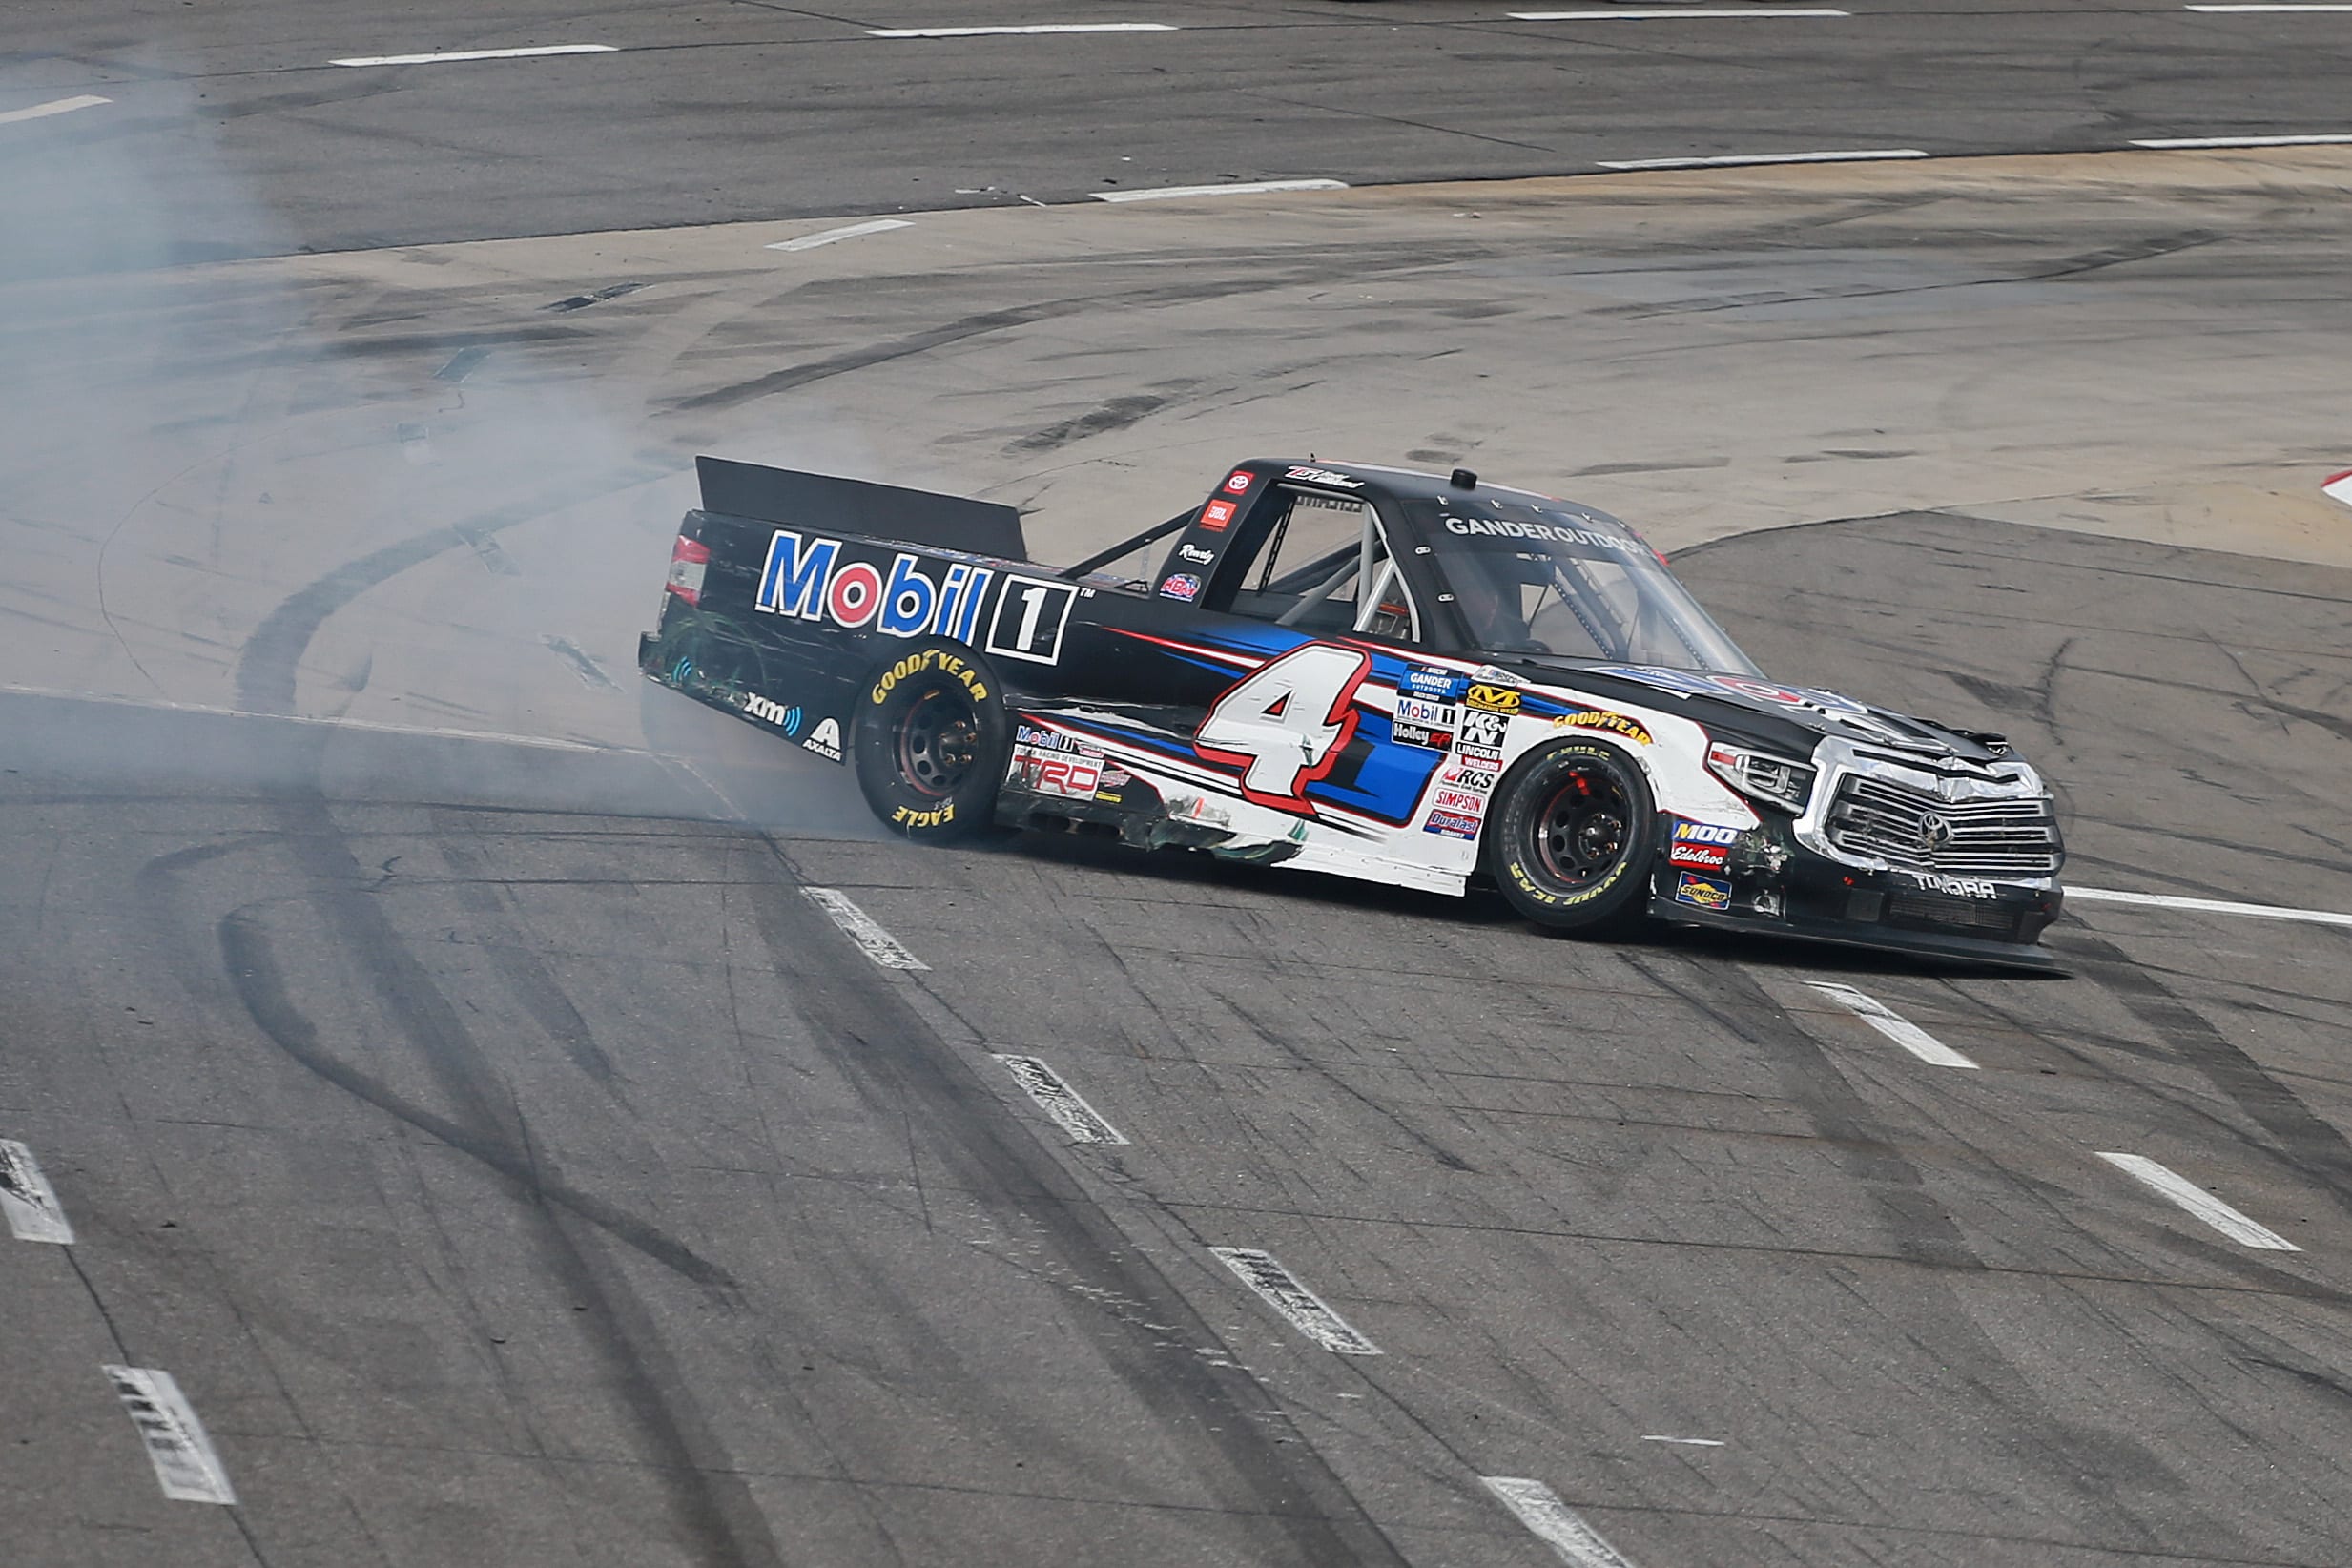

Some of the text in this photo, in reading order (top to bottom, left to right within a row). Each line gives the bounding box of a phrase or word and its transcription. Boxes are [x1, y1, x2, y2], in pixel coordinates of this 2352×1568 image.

[1445, 517, 1656, 560] GANDER OUTDOO
[754, 530, 994, 647] Mobil
[871, 649, 988, 704] GOODYEAR
[1410, 672, 1452, 689] GANDER
[1397, 699, 1438, 722] Mobil
[1016, 725, 1060, 750] Mobil
[1194, 640, 1372, 814] 4
[1393, 722, 1430, 745] Holley
[1553, 712, 1653, 746] GOODYEAR
[802, 739, 843, 762] AXALTA
[1456, 742, 1499, 761] LINCOLN
[1014, 755, 1099, 794] TRD
[1457, 770, 1495, 788] RCS
[1435, 791, 1482, 813] SIMPSON
[891, 803, 955, 827] EAGLE
[1432, 813, 1477, 831] Duralast
[1674, 823, 1738, 844] MOO
[1671, 846, 1723, 865] Edelbroc
[1681, 885, 1725, 901] SUNOCO
